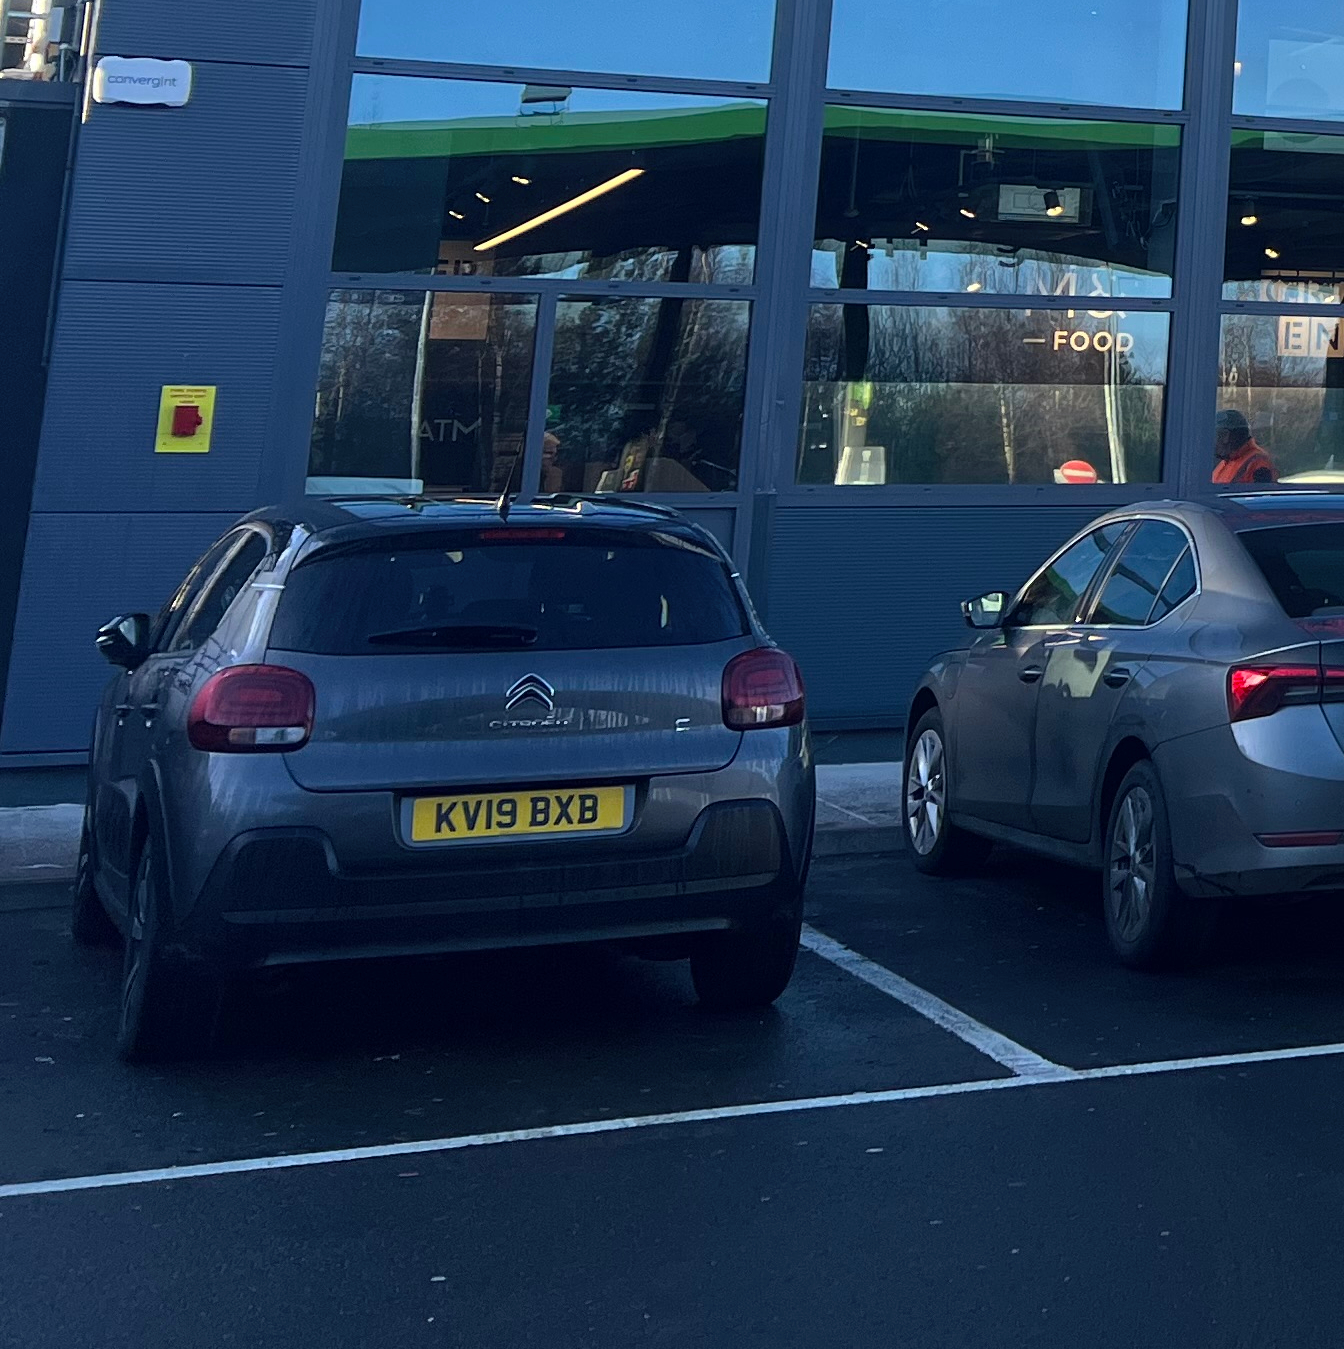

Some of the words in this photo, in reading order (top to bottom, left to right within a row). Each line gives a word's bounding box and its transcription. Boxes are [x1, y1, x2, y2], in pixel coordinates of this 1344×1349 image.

[107, 75, 177, 88] convergint
[1053, 330, 1135, 352] FOOD
[419, 418, 482, 442] ATM
[434, 798, 518, 833] KV19
[529, 794, 599, 827] BXB
